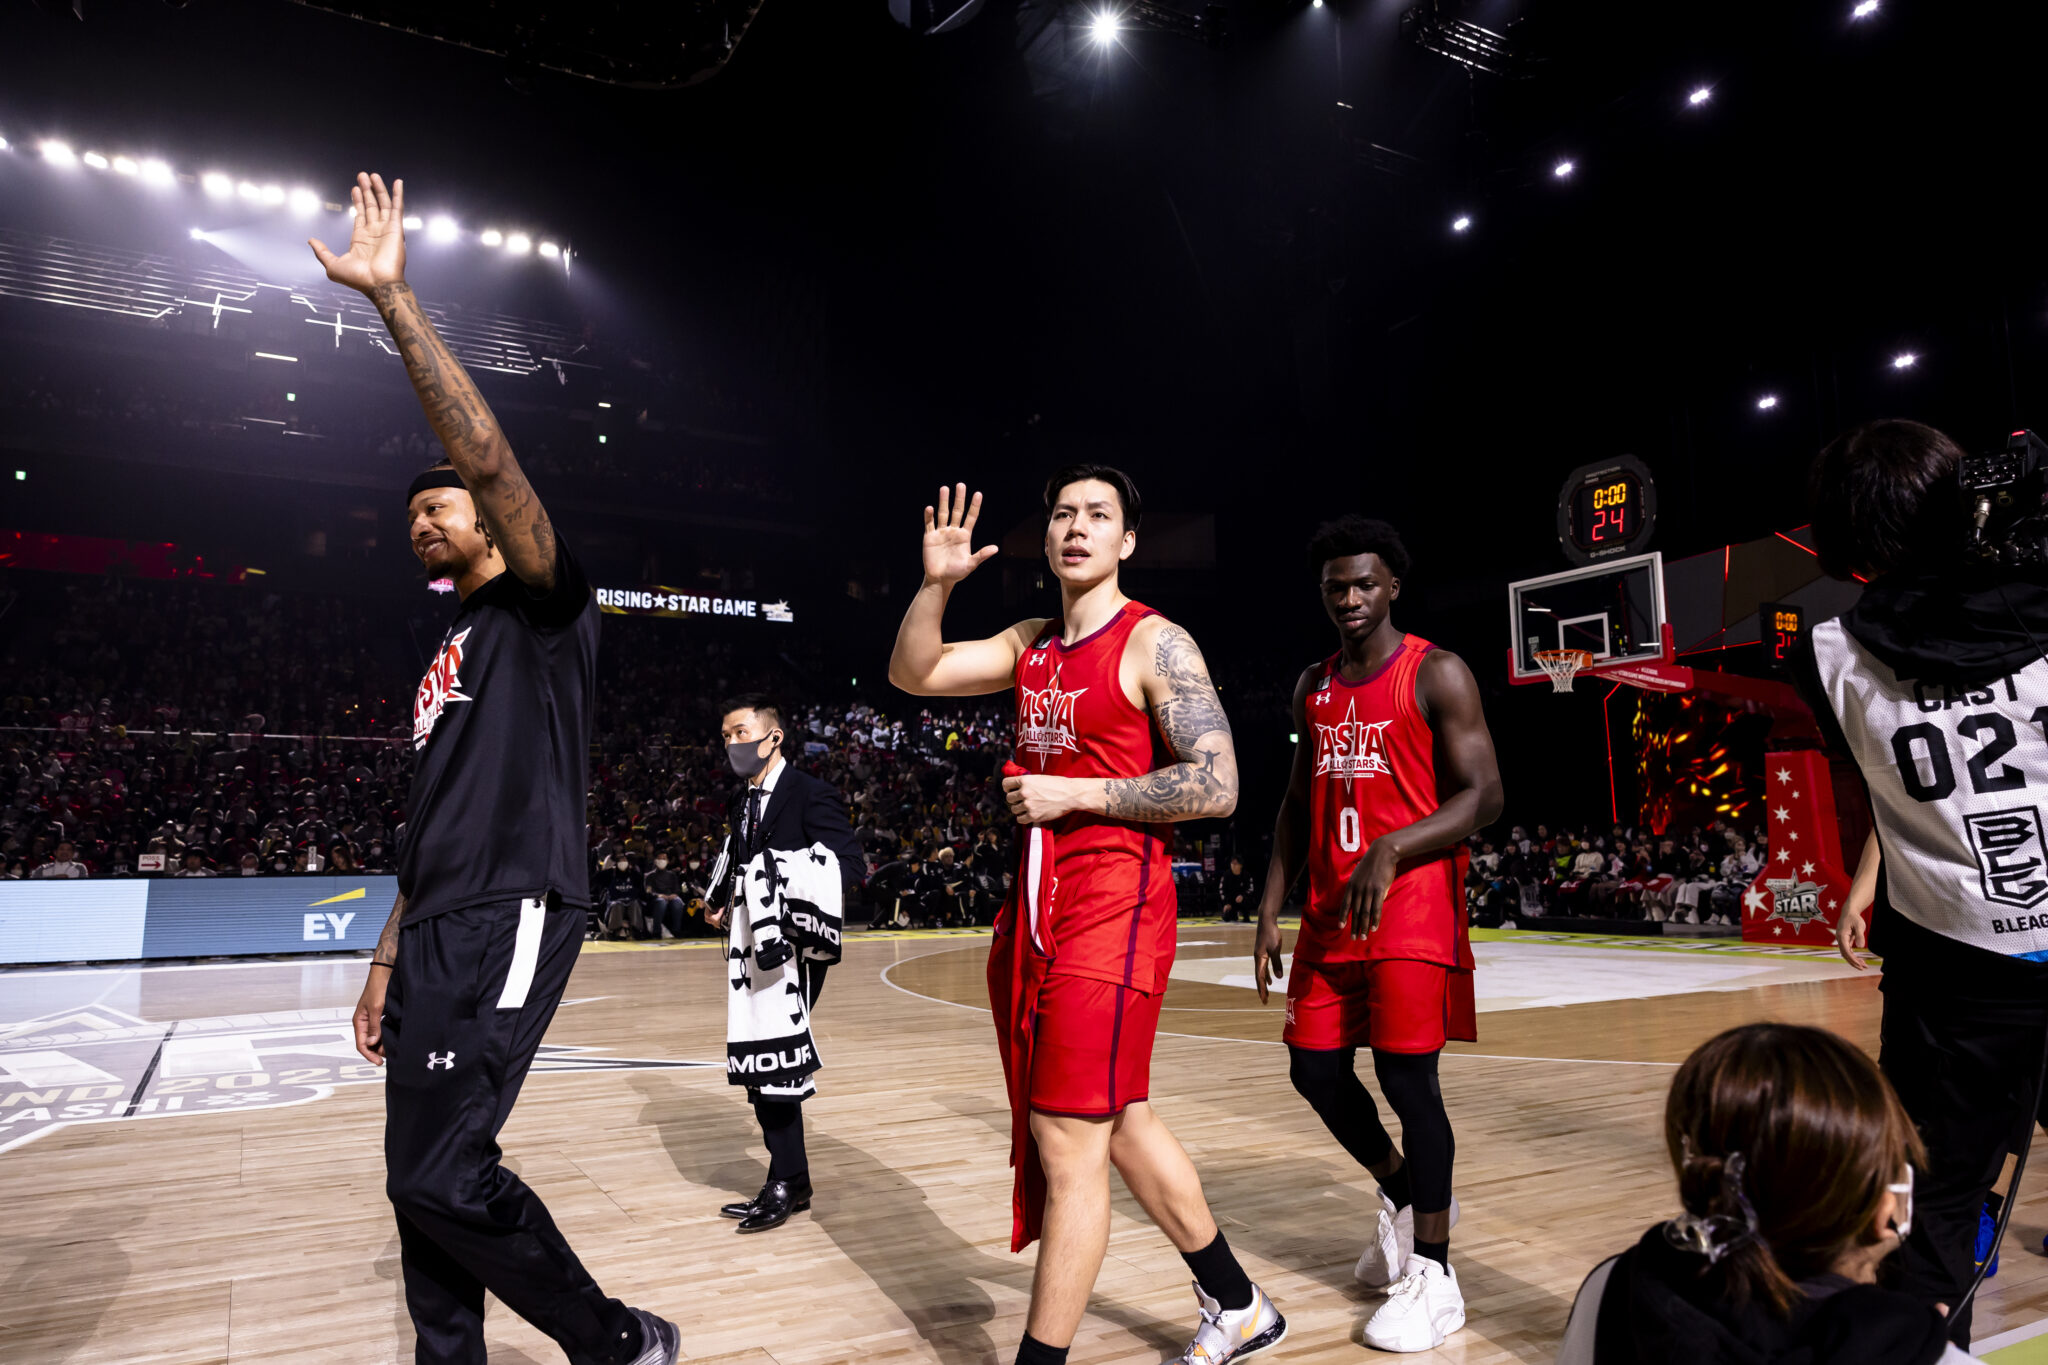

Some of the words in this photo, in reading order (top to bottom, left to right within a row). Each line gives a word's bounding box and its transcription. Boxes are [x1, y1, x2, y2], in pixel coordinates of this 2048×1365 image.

[1594, 483, 1626, 509] 0:00
[1592, 508, 1624, 541] 24
[597, 588, 652, 609] RISING
[668, 595, 710, 613] STAR
[713, 600, 757, 617] GAME
[1776, 612, 1798, 632] 0:00
[1019, 689, 1076, 736] ASIA
[1044, 731, 1064, 744] STARS
[1318, 723, 1388, 766] ASIA
[1348, 758, 1375, 769] STARS
[1340, 807, 1361, 853] 0
[1775, 893, 1821, 913] STAR
[303, 912, 356, 941] EY
[0, 1085, 125, 1107] ND
[154, 1064, 386, 1095] 2025
[0, 1096, 184, 1123] ASHI
